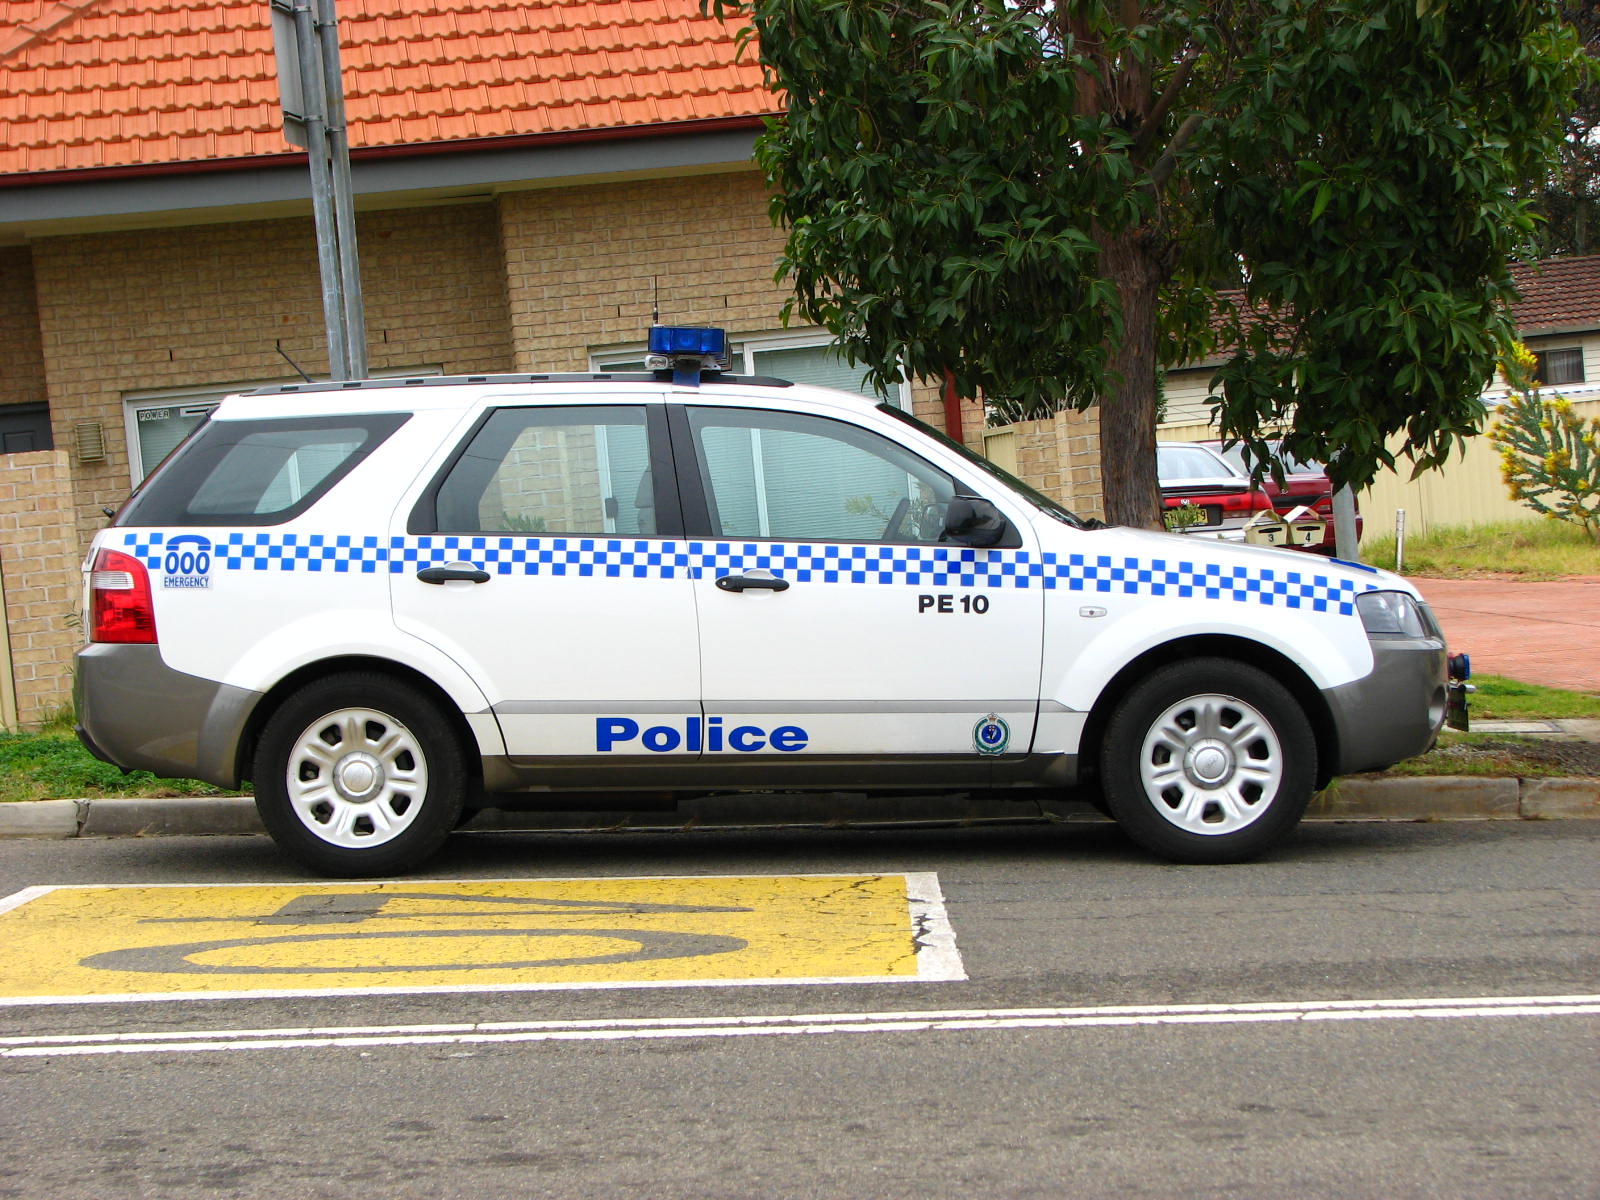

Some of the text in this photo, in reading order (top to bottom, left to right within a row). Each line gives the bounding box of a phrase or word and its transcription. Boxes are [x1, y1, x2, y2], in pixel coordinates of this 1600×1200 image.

[139, 411, 169, 421] POWER
[1268, 534, 1274, 542] 3
[1305, 532, 1311, 542] 4
[165, 551, 210, 574] 000
[164, 576, 209, 588] EMERGENCY
[918, 595, 989, 614] PE 10
[596, 717, 809, 752] Police
